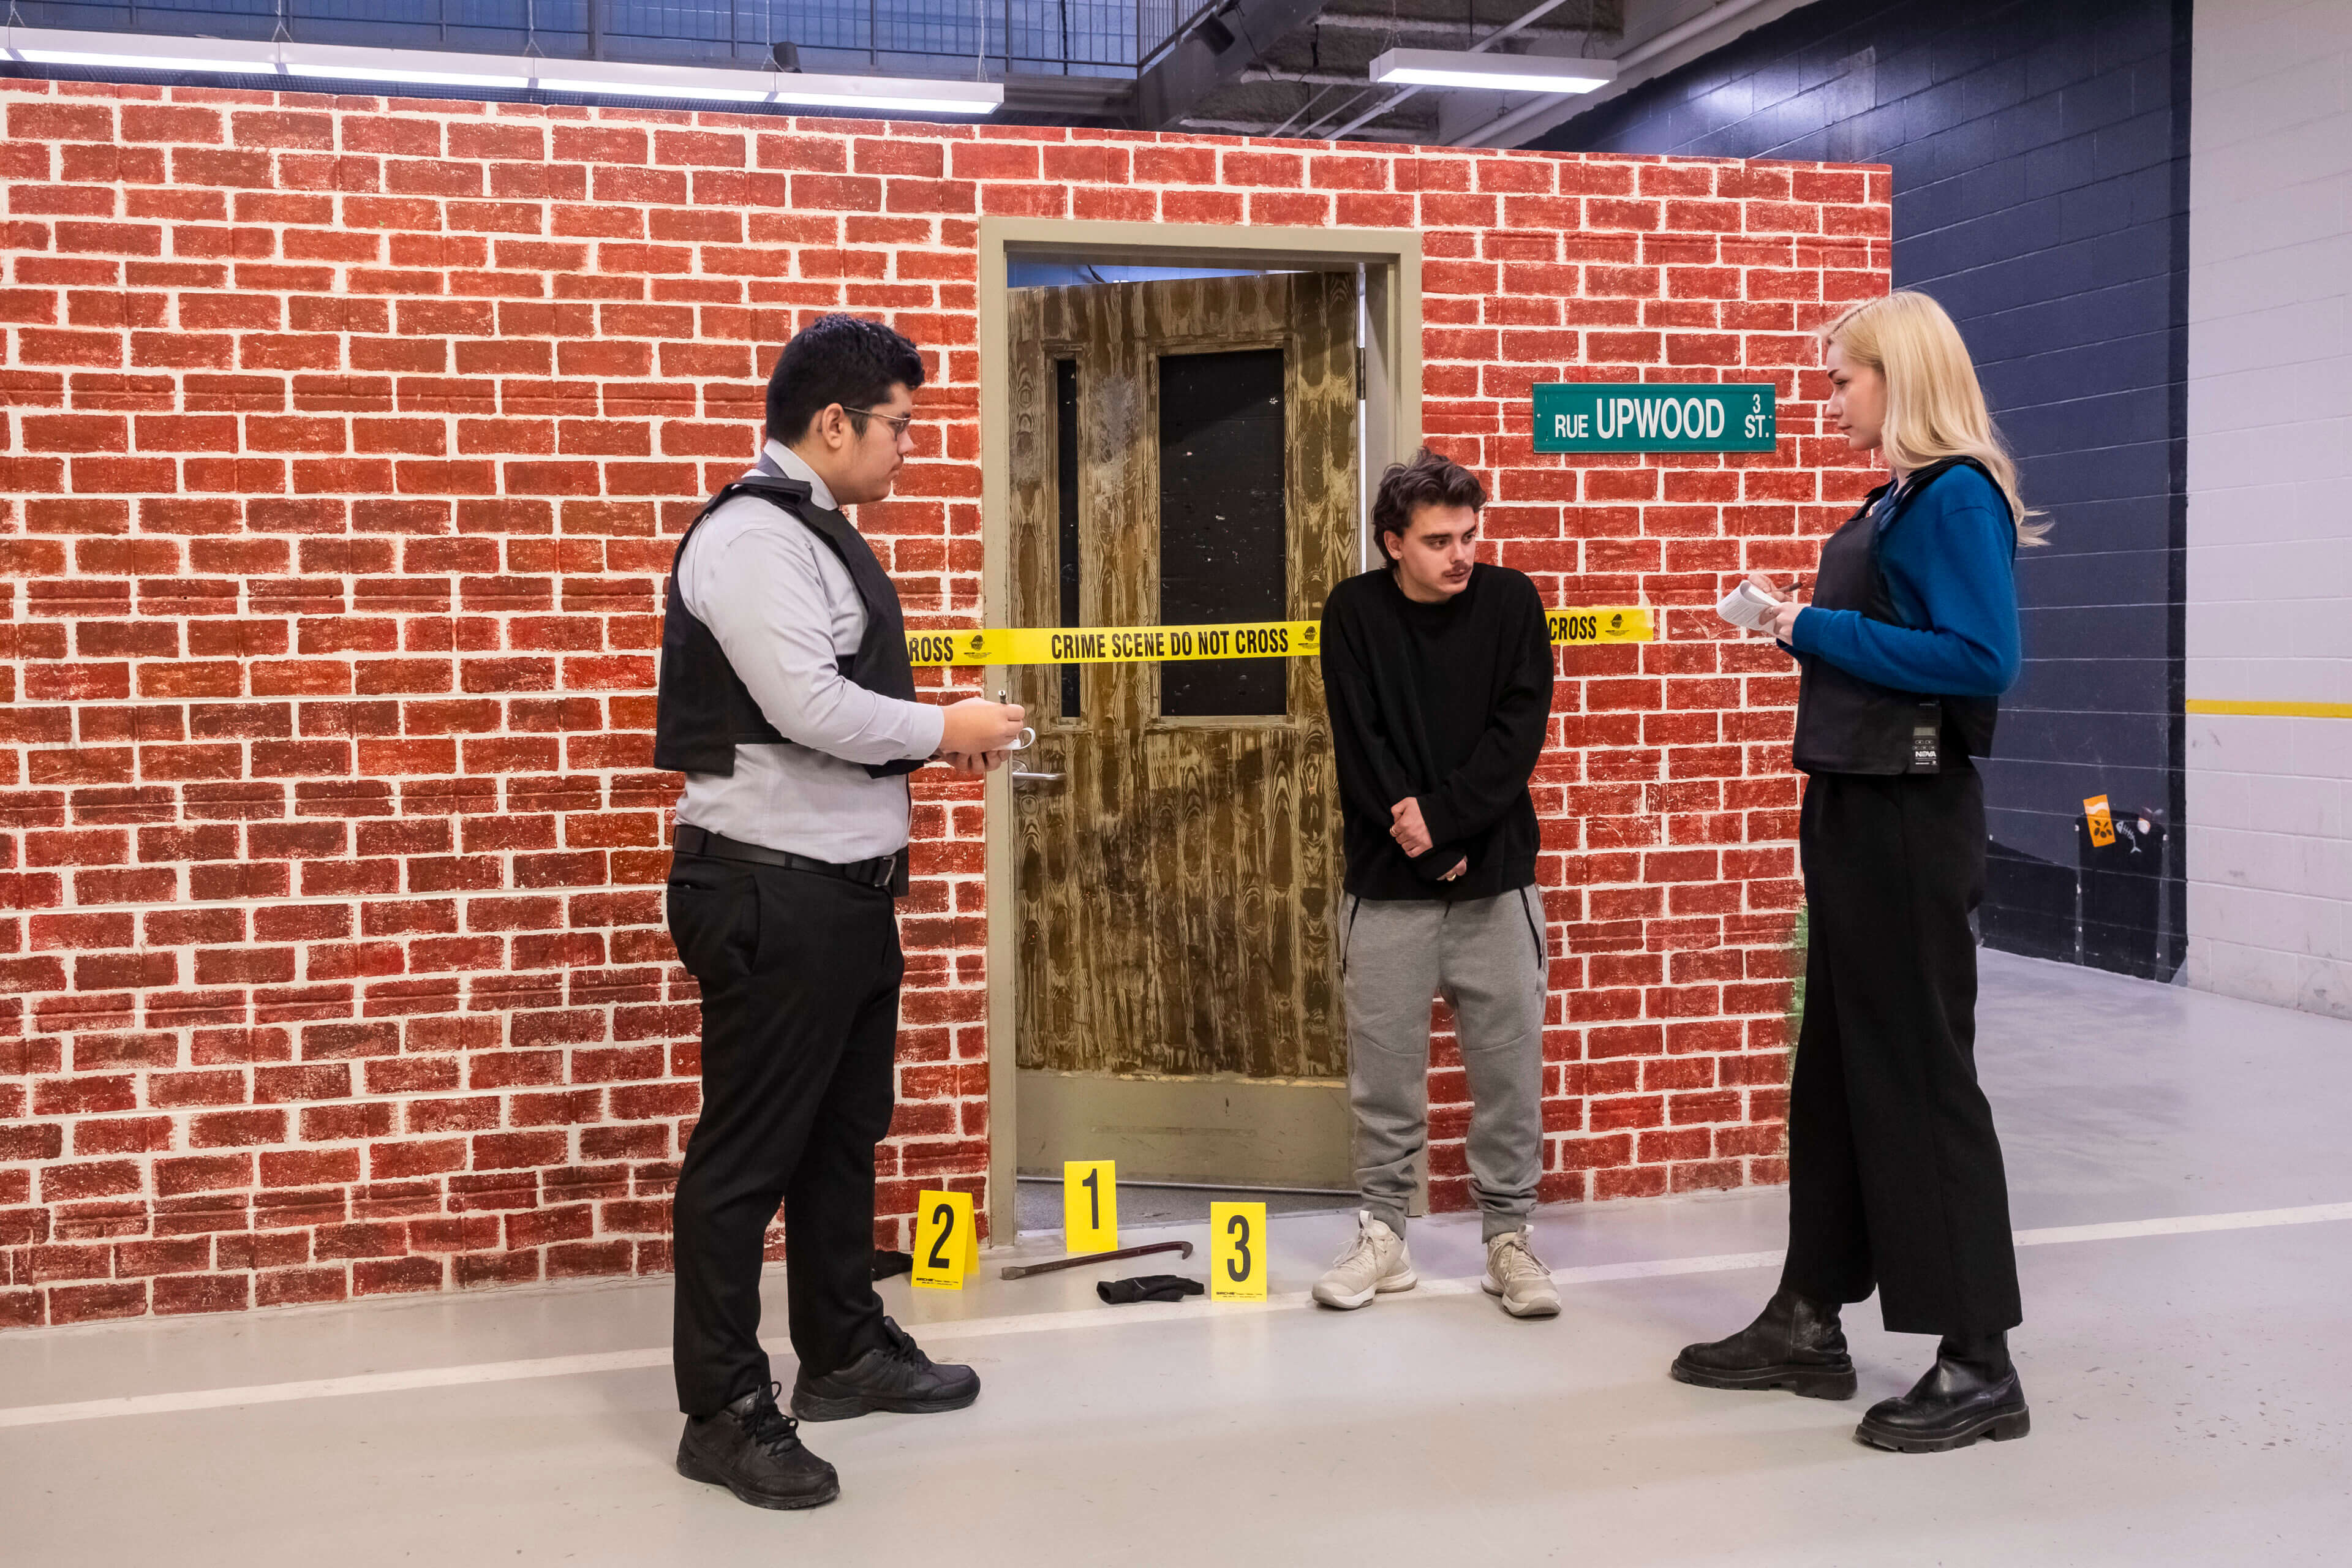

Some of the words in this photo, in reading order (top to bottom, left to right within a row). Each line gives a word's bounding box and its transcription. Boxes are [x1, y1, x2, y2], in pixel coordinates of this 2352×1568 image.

[1555, 414, 1589, 438] RUE
[1596, 398, 1725, 439] UPWOOD
[1744, 415, 1770, 439] ST.
[1752, 394, 1761, 413] 3
[909, 636, 954, 662] ROSS
[1052, 634, 1106, 659] CRIME
[1112, 632, 1165, 658] SCENE
[1170, 631, 1192, 656] DO
[1198, 630, 1229, 655] NOT
[1235, 628, 1289, 654] CROSS
[1548, 616, 1597, 641] CROSS
[1082, 1168, 1099, 1229] 1
[928, 1204, 954, 1269] 2
[1227, 1215, 1251, 1282] 3
